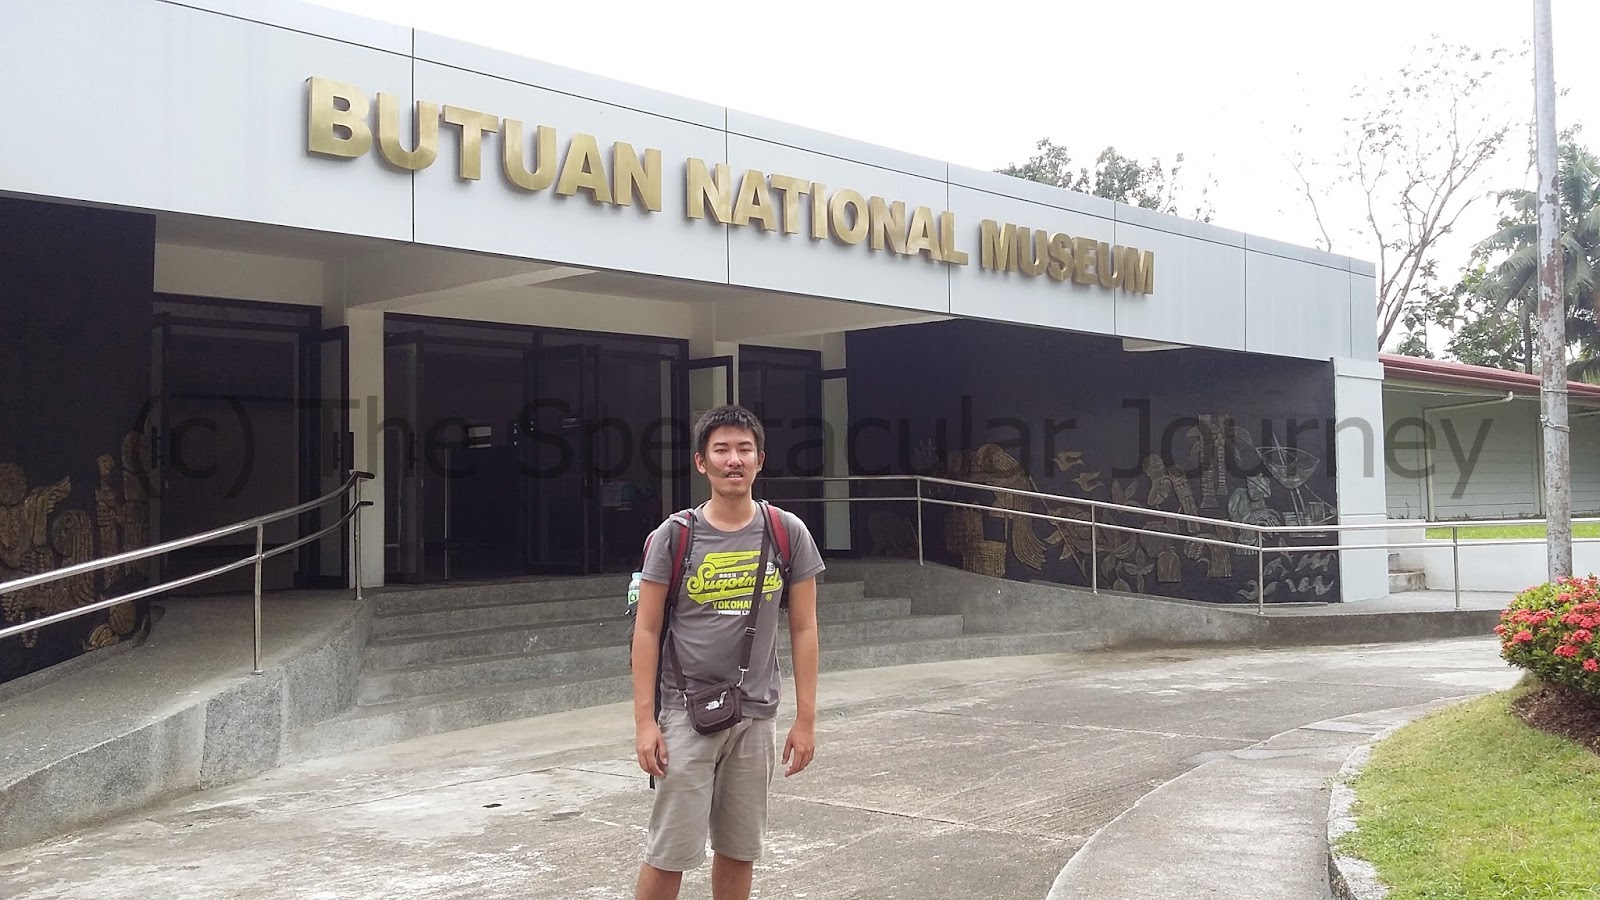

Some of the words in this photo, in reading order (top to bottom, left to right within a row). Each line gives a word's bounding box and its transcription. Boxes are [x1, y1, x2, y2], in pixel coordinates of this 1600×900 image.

[306, 75, 662, 213] BUTUAN
[686, 156, 969, 266] NATIONAL
[981, 218, 1155, 295] MUSEUM
[712, 600, 760, 610] YOKOHA
